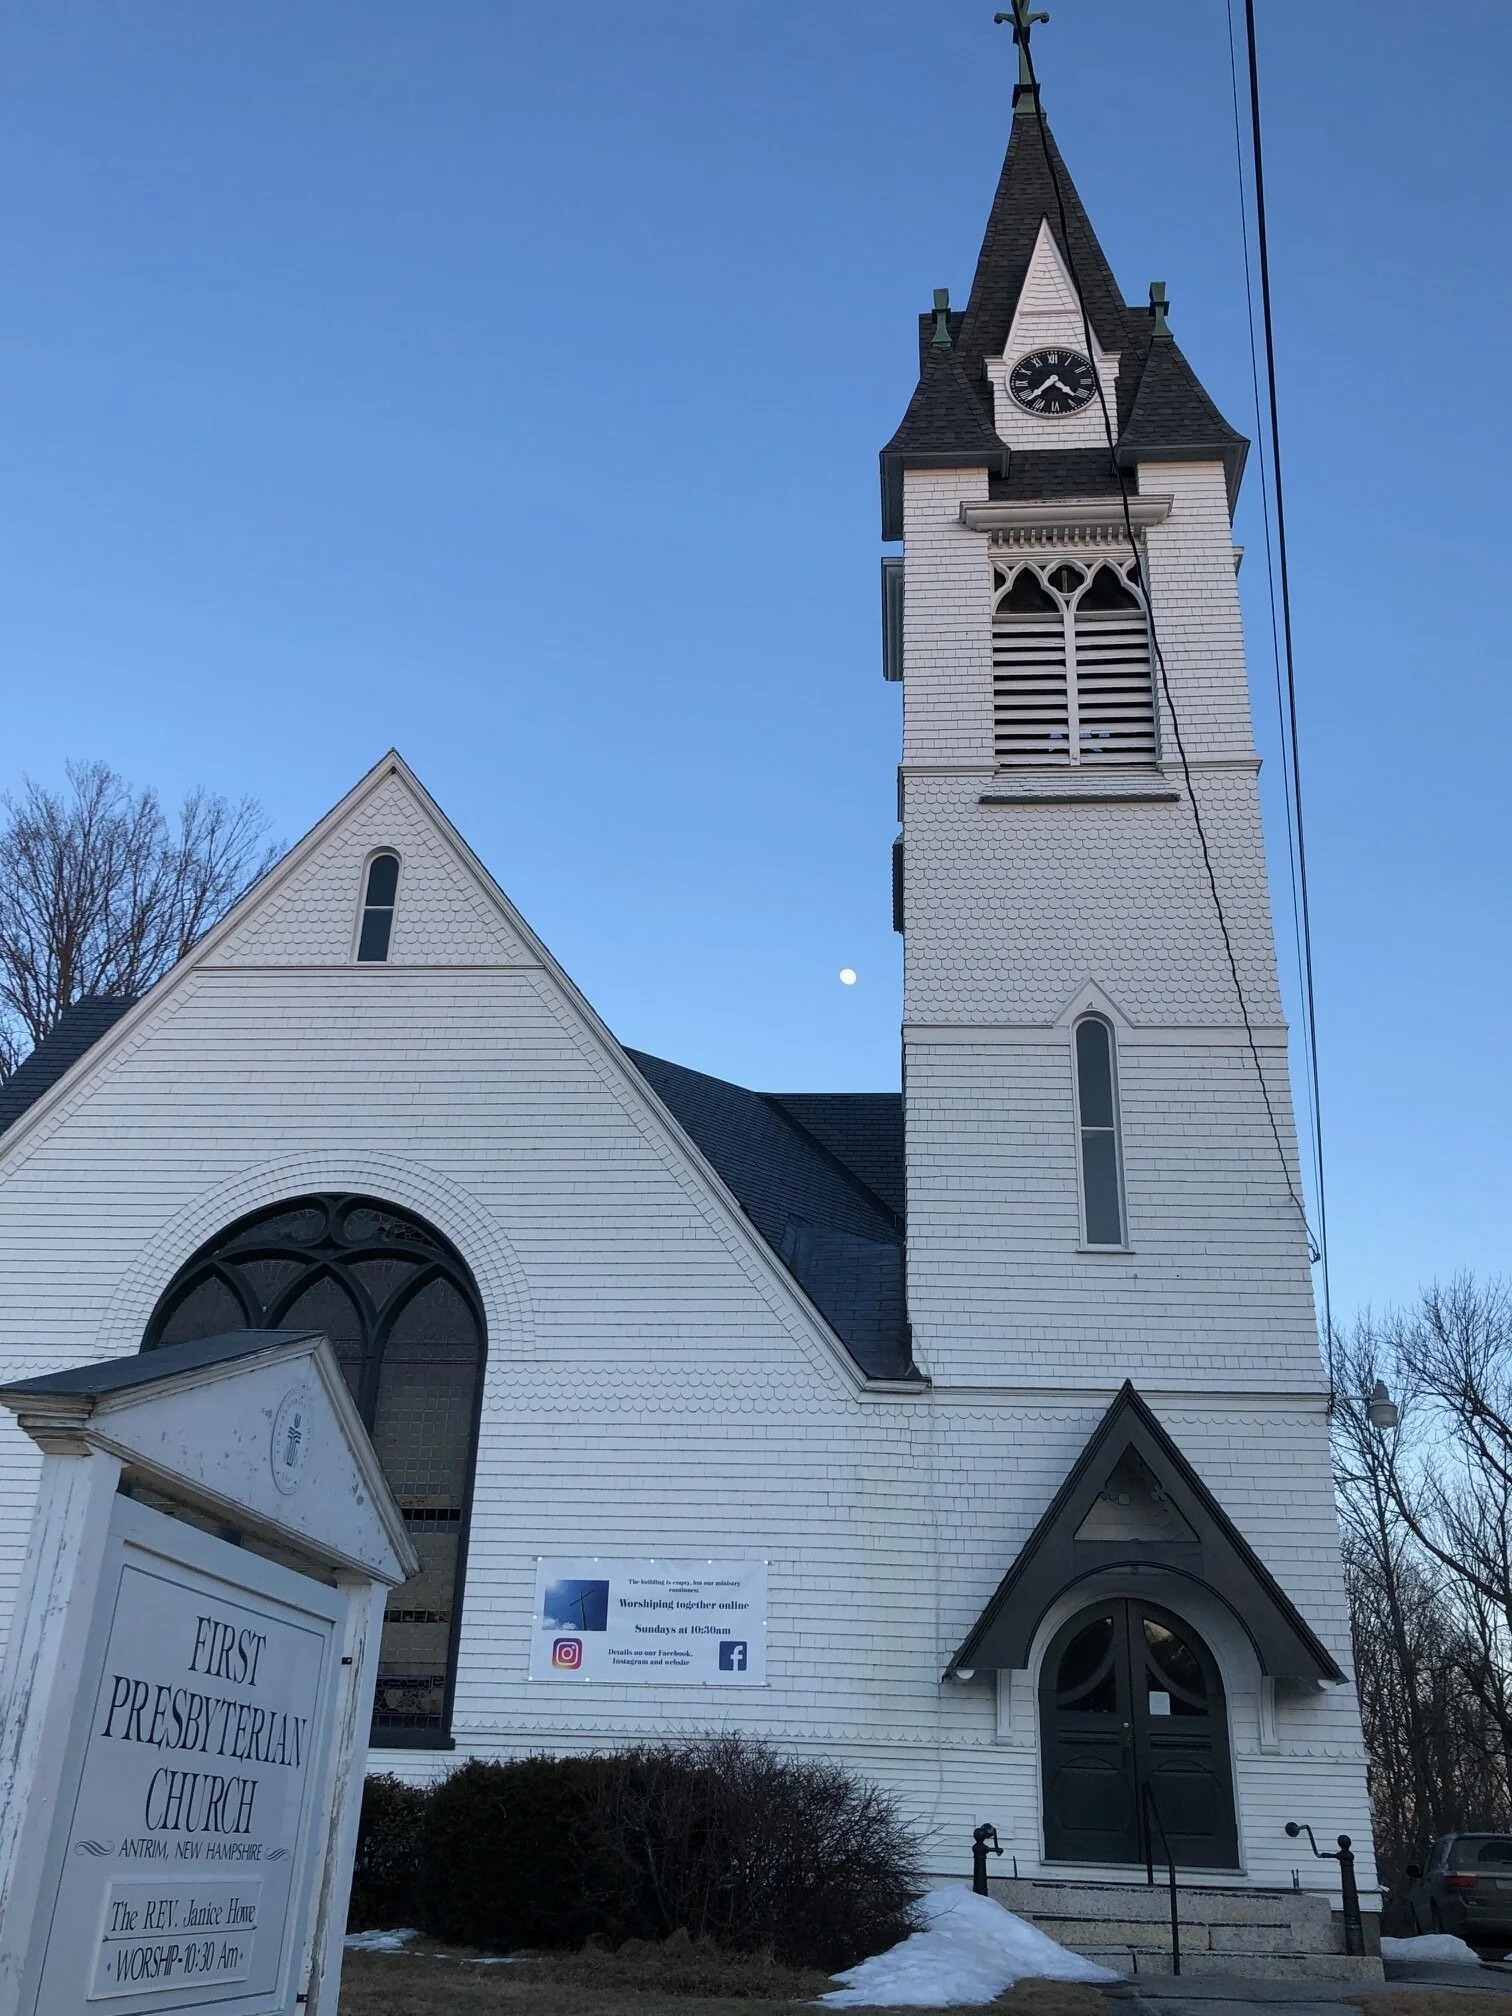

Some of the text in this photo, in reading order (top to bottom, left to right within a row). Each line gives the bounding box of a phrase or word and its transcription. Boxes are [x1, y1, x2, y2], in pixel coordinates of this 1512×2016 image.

[619, 1598, 749, 1610] Worshiping together online
[634, 1624, 731, 1635] Sundays at 10:30am
[188, 1616, 266, 1686] FIRST
[608, 1648, 632, 1656] Details
[613, 1658, 648, 1666] Instagram
[101, 1674, 307, 1769] PRESBYTERIAN
[145, 1766, 259, 1834] CHURCH
[118, 1838, 263, 1861] ANTRIM, NEW HAMPSHIRE
[111, 1897, 256, 1932] The REV. Janice Howe
[217, 1940, 240, 1969] Am
